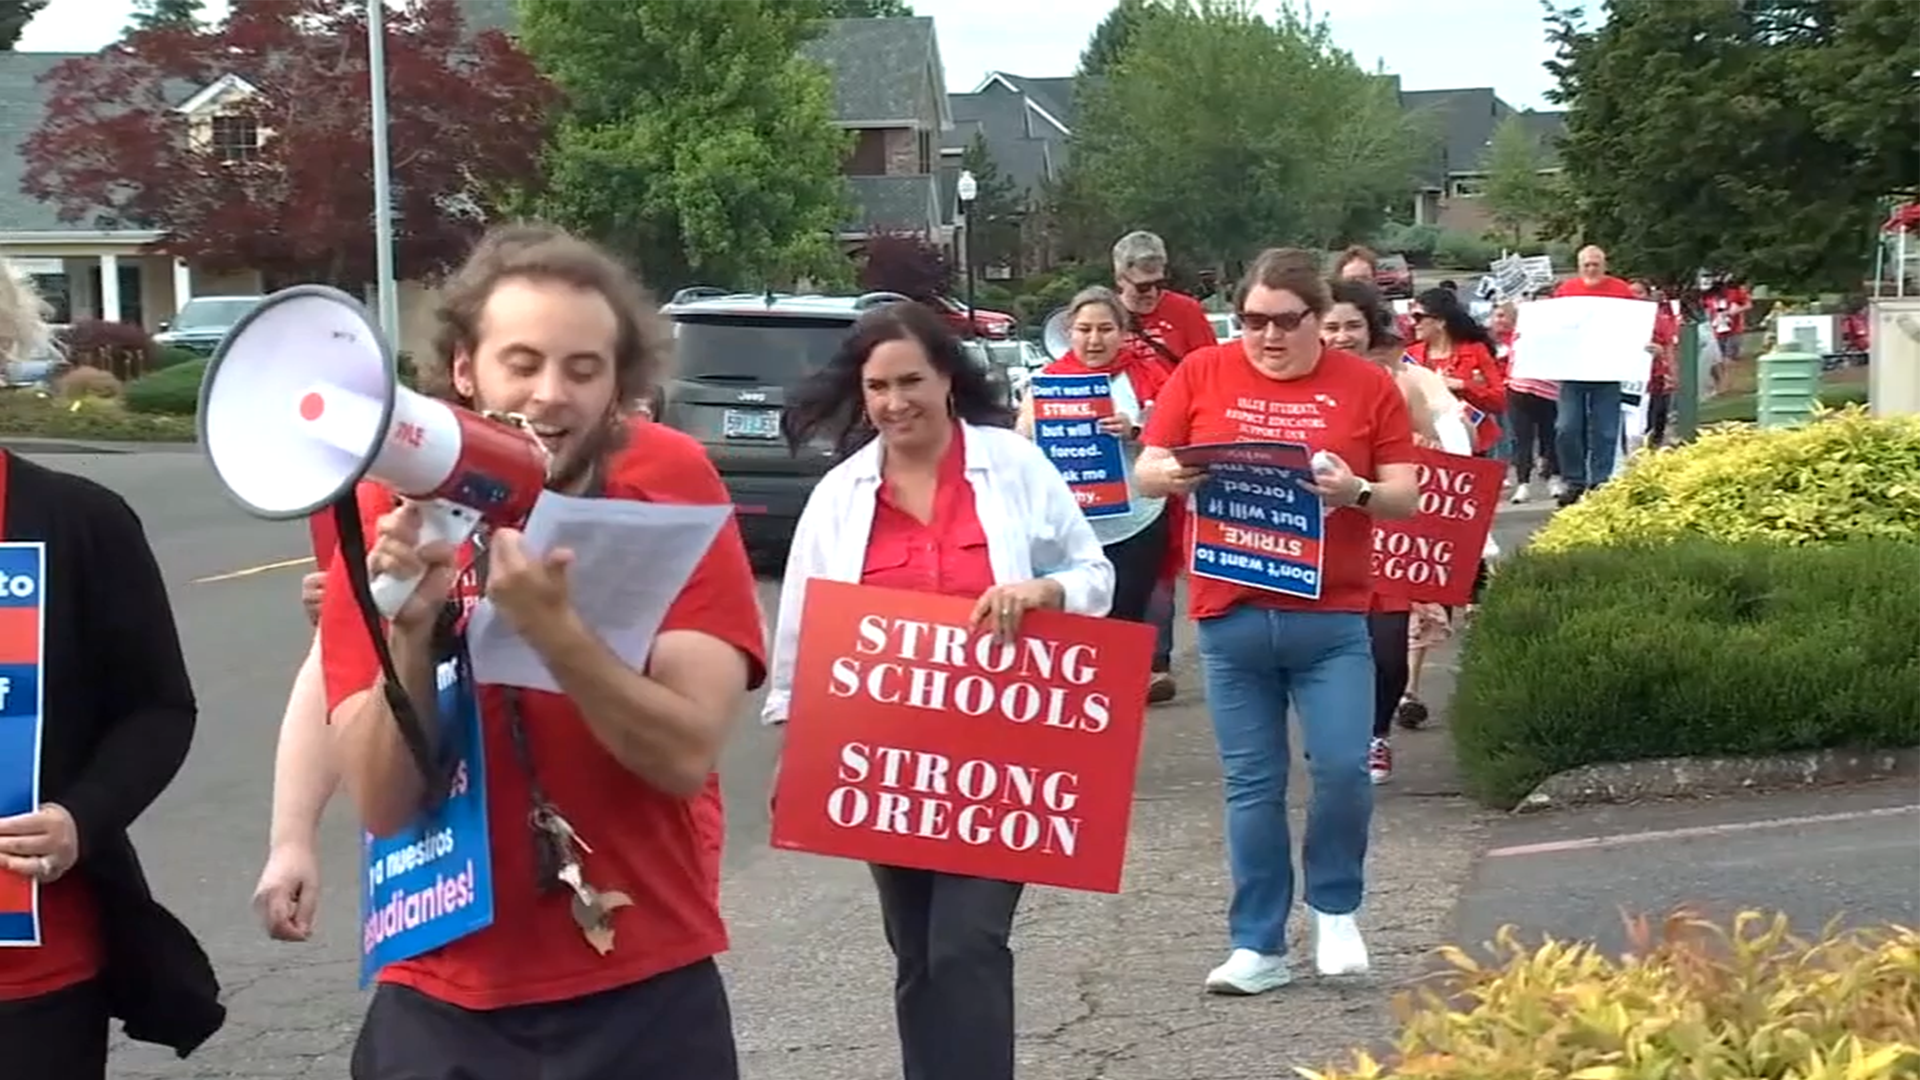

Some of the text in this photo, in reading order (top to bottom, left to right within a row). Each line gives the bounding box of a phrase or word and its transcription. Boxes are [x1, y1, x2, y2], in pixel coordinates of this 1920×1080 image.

[737, 389, 766, 402] Jeep
[1063, 386, 1091, 396] want
[1094, 384, 1110, 395] to
[1042, 424, 1065, 437] but
[1067, 423, 1092, 436] will
[1050, 445, 1102, 458] forced.
[1082, 469, 1107, 480] me
[1249, 465, 1291, 479] Ask
[1208, 497, 1308, 531] but will if
[1219, 522, 1302, 556] STRIKE,
[1196, 548, 1316, 585] Don't want to
[855, 613, 1099, 686] STRONG
[827, 655, 1111, 734] SCHOOLS
[837, 741, 1079, 812] STRONG
[826, 785, 1084, 858] OREGON
[386, 827, 454, 878] nuestros
